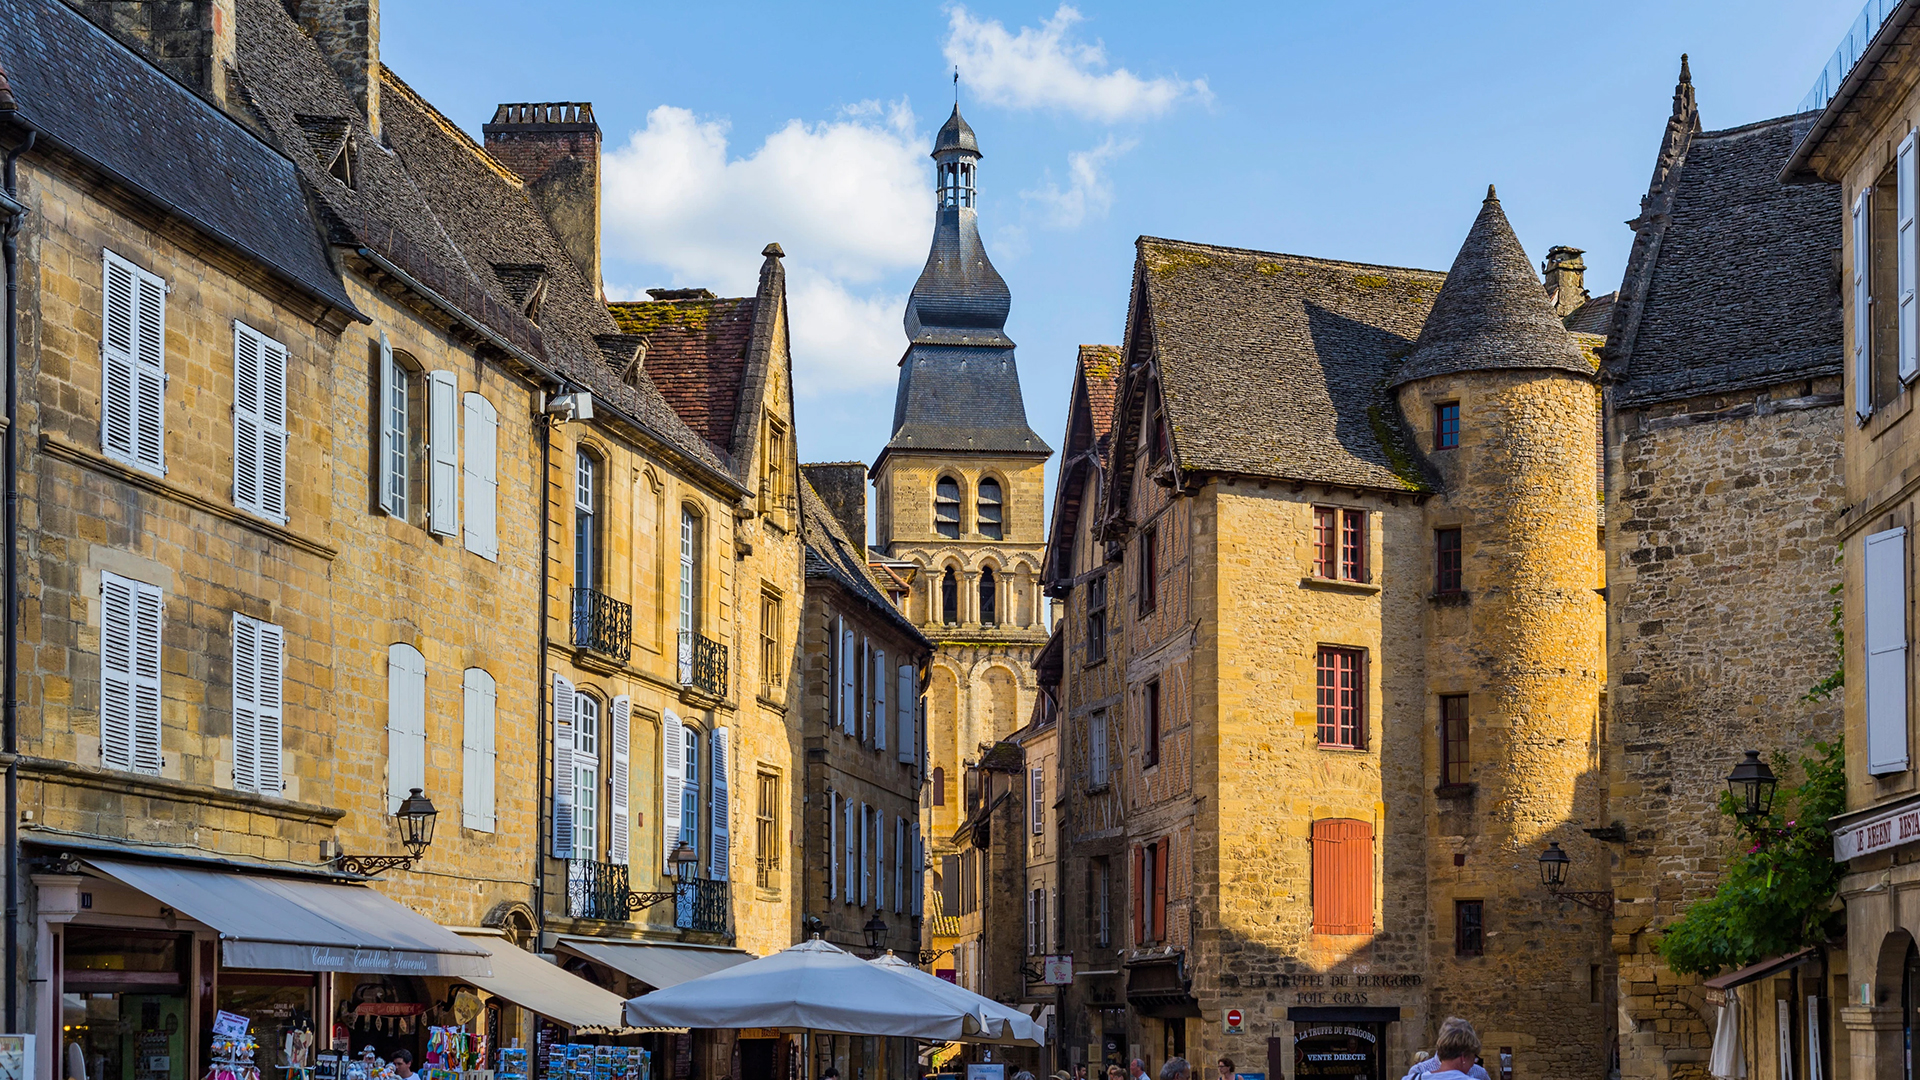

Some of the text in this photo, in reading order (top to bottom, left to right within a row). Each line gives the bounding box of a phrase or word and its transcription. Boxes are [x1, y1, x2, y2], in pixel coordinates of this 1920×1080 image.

[1855, 812, 1920, 852] LE REGENT RESTA
[311, 946, 428, 971] Cadeaux Coutellerie Souvenirs
[1274, 974, 1324, 987] TRUFFE
[1330, 974, 1348, 987] DU
[1357, 974, 1422, 987] PERIGORD
[1297, 991, 1368, 1004] FOIE GRAS
[1299, 1030, 1308, 1041] LA
[1308, 1026, 1333, 1037] TRUFFE
[1333, 1026, 1343, 1035] DU
[1333, 1053, 1366, 1061] DIRECTE
